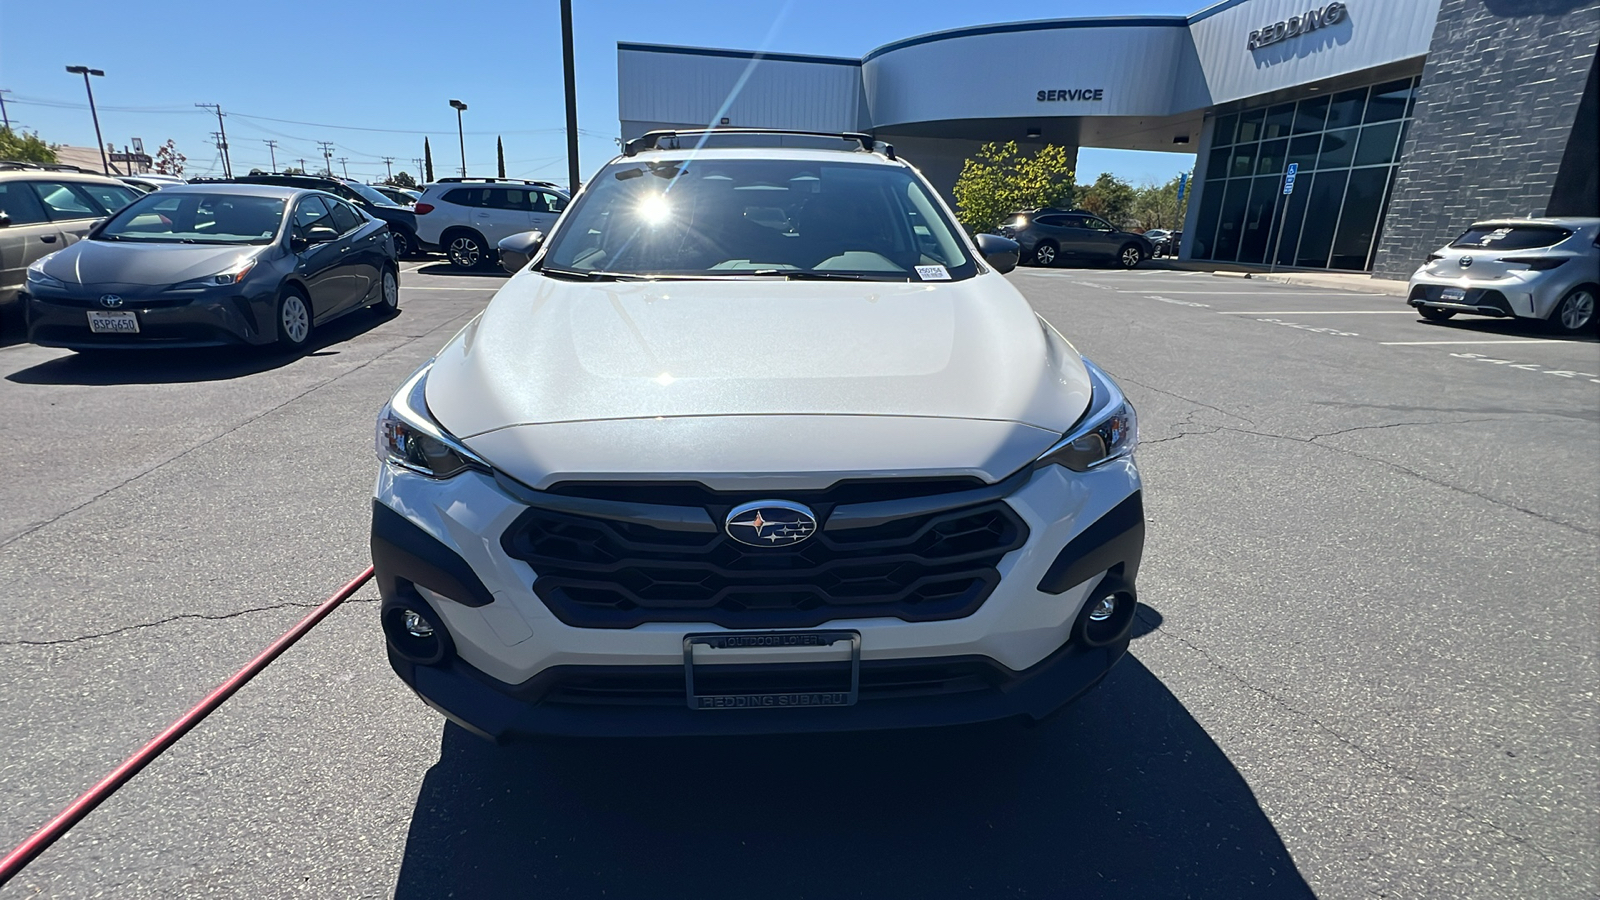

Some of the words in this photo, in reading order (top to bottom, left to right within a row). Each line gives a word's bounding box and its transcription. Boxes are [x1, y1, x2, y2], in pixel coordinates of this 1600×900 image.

[1247, 2, 1346, 50] REDDING
[1037, 89, 1104, 101] SERVICE
[93, 319, 135, 330] 8SPG650
[727, 636, 780, 647] OUTDOOR
[783, 635, 818, 645] LOVER
[703, 695, 774, 708] REDDING
[778, 694, 843, 706] SUBARU
